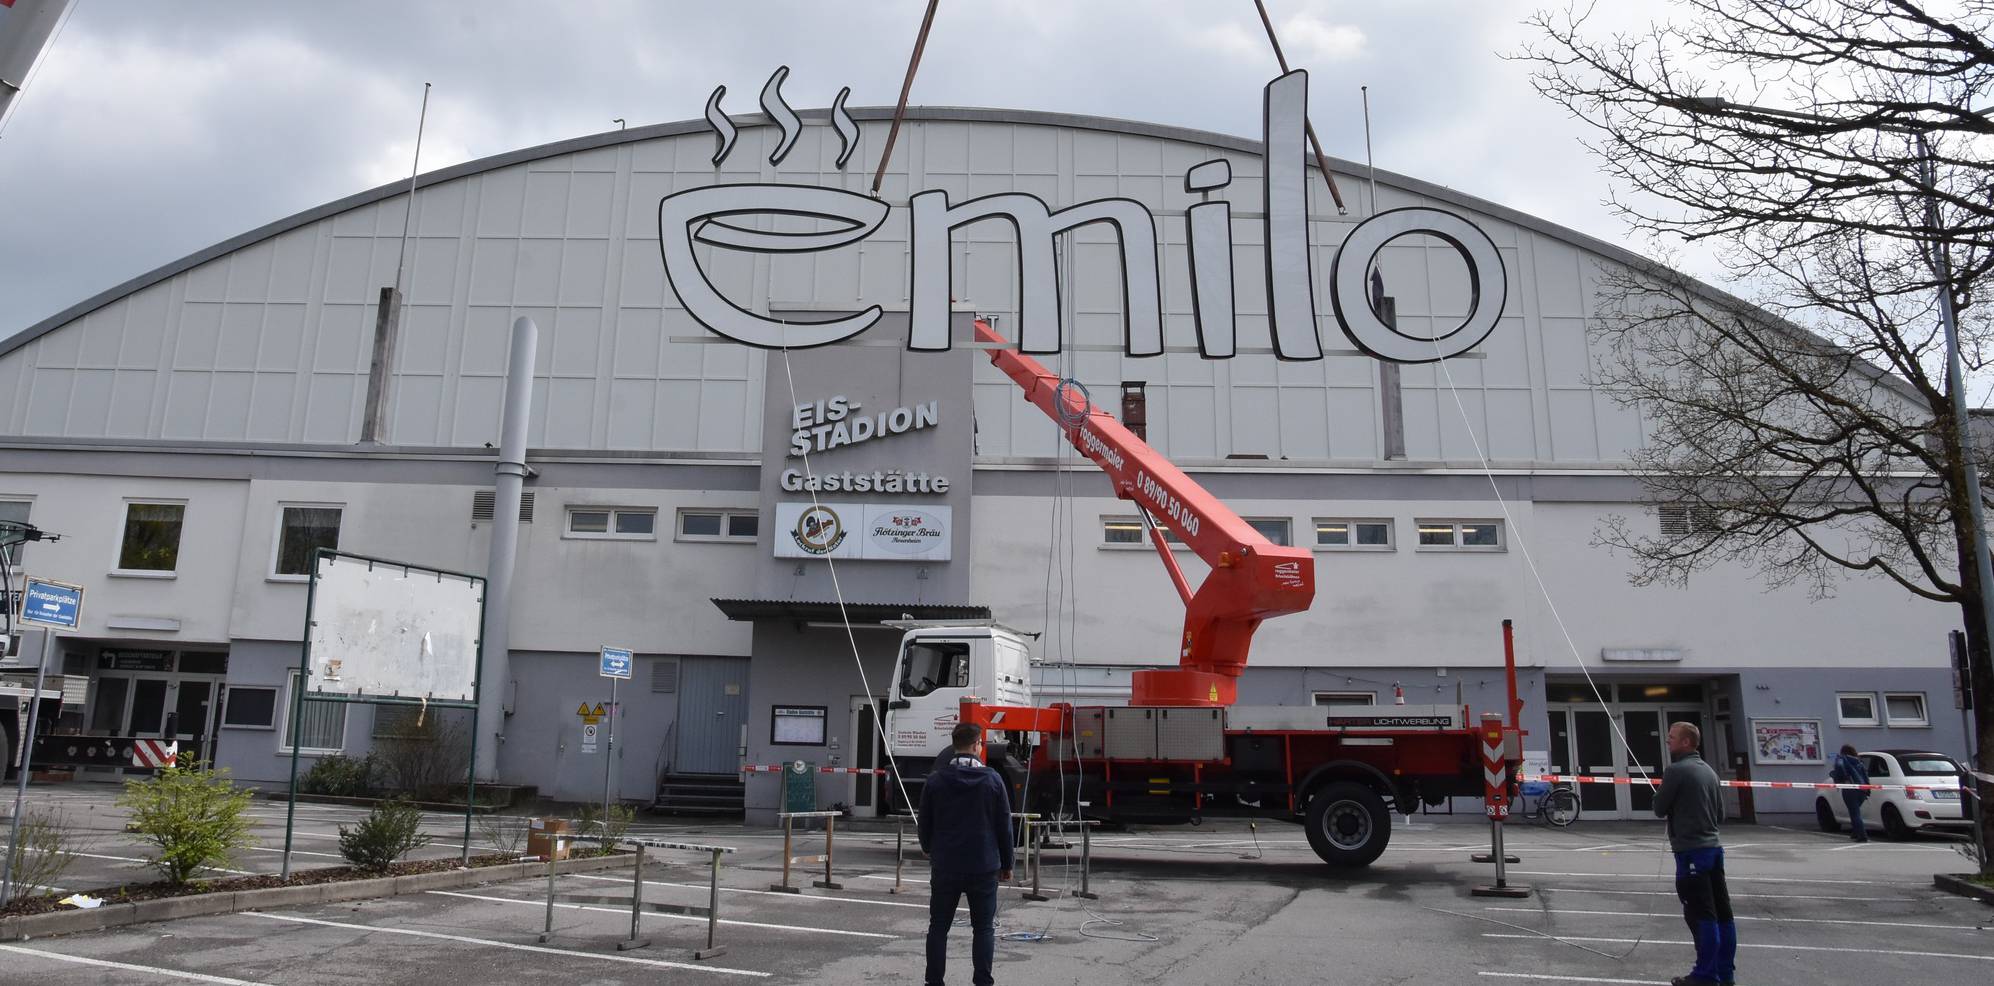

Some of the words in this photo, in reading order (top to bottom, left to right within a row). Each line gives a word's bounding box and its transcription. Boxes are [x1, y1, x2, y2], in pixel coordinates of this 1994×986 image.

[659, 69, 1507, 362] emilo
[790, 400, 938, 457] STADION
[792, 395, 862, 430] EIS-
[1080, 427, 1124, 472] roggermaier
[781, 468, 949, 494] Gaststätte
[917, 527, 941, 537] Bräu
[1374, 718, 1449, 726] LICHTWERBUNG
